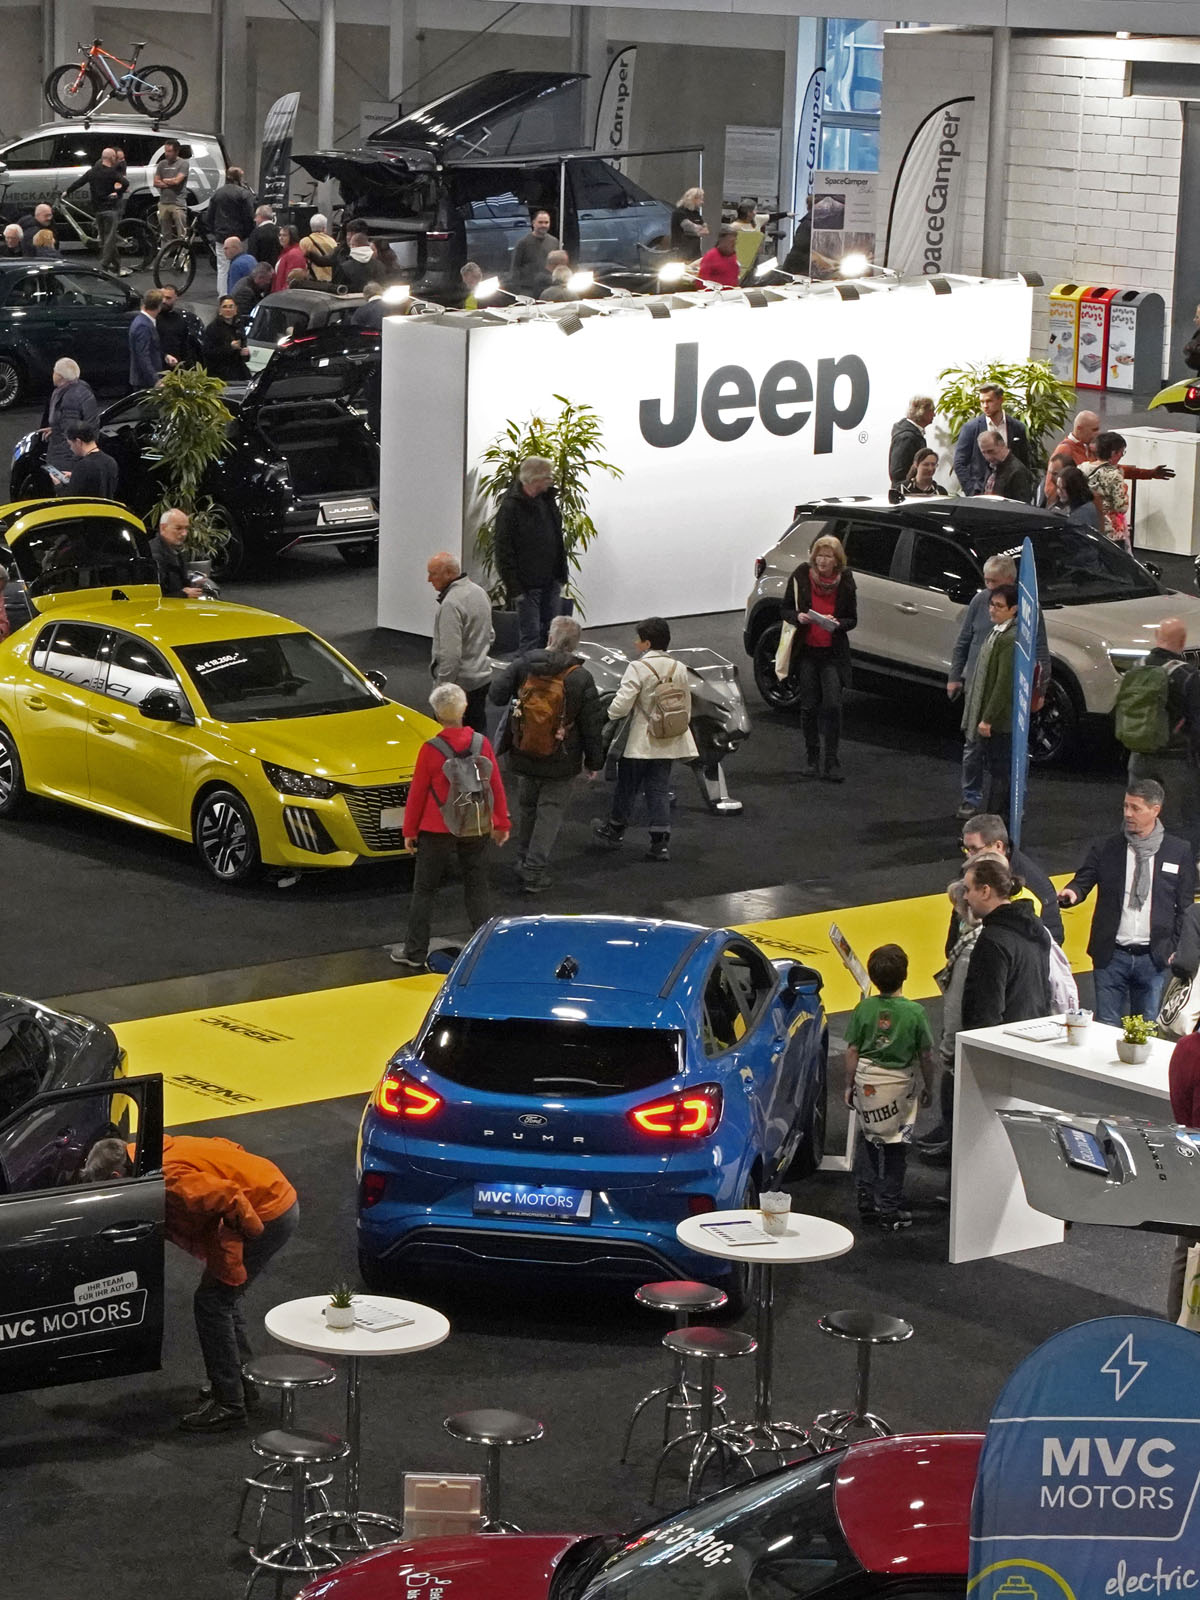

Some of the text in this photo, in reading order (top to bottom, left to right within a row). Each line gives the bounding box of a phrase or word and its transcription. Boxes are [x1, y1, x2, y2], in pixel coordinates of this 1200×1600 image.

[824, 176, 868, 186] SpaceCamper
[639, 342, 870, 455] Jeep
[328, 505, 369, 514] JUNIOR
[200, 1017, 282, 1043] ZGONC
[171, 1075, 257, 1103] ZGONC
[523, 1115, 543, 1125] Ford
[484, 1129, 585, 1143] PUMA
[478, 1190, 574, 1208] MVC MOTORS
[78, 1281, 135, 1302] FÜR IHR AUTO!
[87, 1276, 124, 1292] IHR TEAM
[42, 1301, 132, 1334] MOTORS
[1042, 1437, 1176, 1478] MVC
[1040, 1485, 1175, 1511] MOTORS
[1105, 1557, 1200, 1598] electric
